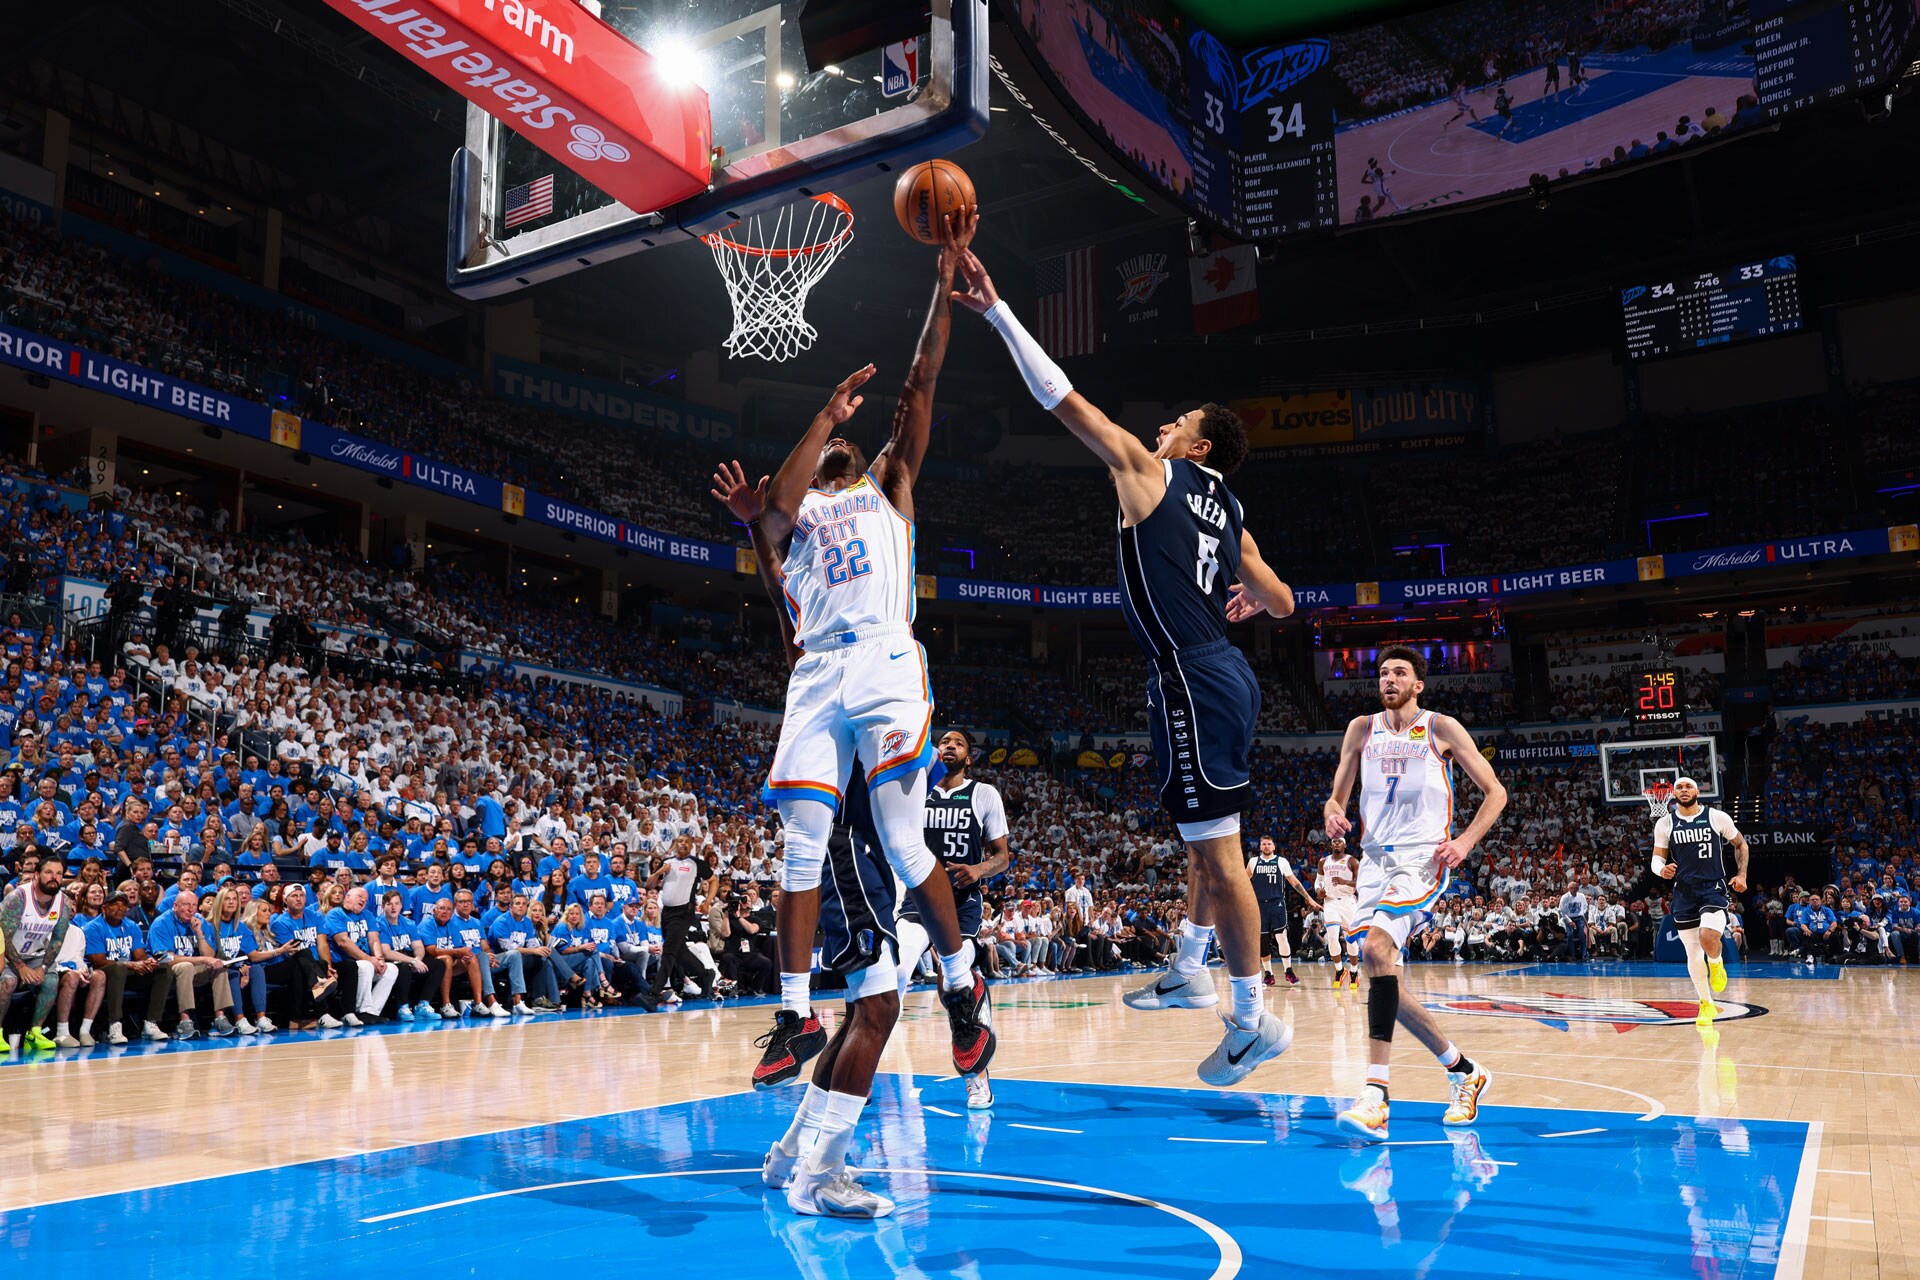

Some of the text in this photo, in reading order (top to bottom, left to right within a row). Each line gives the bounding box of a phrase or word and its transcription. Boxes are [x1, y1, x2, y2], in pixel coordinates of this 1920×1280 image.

[1755, 16, 1784, 33] PLAYER
[1755, 32, 1781, 47] GREEN
[1757, 40, 1798, 61] HARDAWAY
[1799, 37, 1812, 47] JR.
[1852, 33, 1858, 43] 4
[1758, 57, 1795, 76] GAFFORD
[1855, 49, 1860, 58] 0
[888, 75, 905, 91] NBA
[1760, 58, 1877, 90] JONES JR. 10 0
[1761, 88, 1792, 105] DONCIC
[1768, 107, 1779, 117] TO
[1795, 99, 1804, 109] TF
[1808, 95, 1814, 104] 3
[1828, 84, 1846, 97] 2ND
[1857, 75, 1876, 88] 7:46
[1204, 90, 1225, 135] 33
[1267, 102, 1306, 143] 34
[1244, 153, 1267, 163] PLAYER
[1311, 143, 1323, 152] PTS
[1325, 141, 1334, 149] FL
[1244, 158, 1311, 175] GILGEOUS-ALEXANDER
[1245, 179, 1261, 188] DORT
[1245, 188, 1279, 200] HOLMGREN
[1245, 202, 1273, 212] WIGGINS
[1317, 193, 1325, 201] 10
[918, 189, 930, 240] Wilson
[1246, 214, 1274, 225] WALLACE
[1251, 228, 1260, 237] TO
[1298, 221, 1311, 230] 2ND
[1115, 253, 1168, 281] THUNDER
[1740, 264, 1764, 280] 33
[1651, 282, 1675, 299] 34
[1693, 277, 1719, 289] 7:46
[0, 332, 231, 421] RIOR LIGHT BEER
[497, 369, 732, 442] THUNDER UP
[1358, 389, 1476, 434] LOUD CITY
[1249, 435, 1465, 462] BRING THE THUNDER EXIT NOW
[97, 447, 107, 485] 209
[330, 438, 478, 496] Michelob ULTRA
[793, 493, 881, 543] OKLAHOMA
[547, 503, 710, 562] SUPERIOR LIGHT BEER
[818, 516, 858, 547] CITY
[822, 537, 873, 589] 22
[1692, 538, 1857, 571] Michelob ULTRA
[1403, 567, 1606, 599] SUPERIOR LIGHT BEER
[959, 583, 1031, 602] SUPERIOR
[1043, 590, 1088, 605] LIGHT
[1294, 590, 1330, 604] TRA
[68, 594, 107, 620] 106
[1610, 661, 1658, 674] POST OAK
[1350, 680, 1366, 691] POST
[1448, 675, 1492, 687] POST OAK
[1643, 672, 1675, 687] 7:45
[663, 699, 681, 715] 107
[1639, 685, 1676, 710] 20
[1647, 711, 1681, 720] TISSOT
[1172, 709, 1200, 809] MAVERICKS
[1366, 740, 1430, 761] OKLAHOMA
[1499, 749, 1518, 760] THE
[1520, 746, 1567, 758] OFFICIAL
[1567, 744, 1600, 757] TA
[1381, 758, 1408, 774] CITY
[1386, 775, 1401, 805] 7
[923, 807, 972, 829] MAVS
[943, 832, 969, 858] 55
[1673, 827, 1712, 844] MAVS
[1773, 831, 1816, 845] BANK
[1698, 843, 1713, 859] 21
[1256, 865, 1278, 874] MAVS
[1267, 874, 1277, 884] 77
[18, 922, 54, 933] OKLAHOM
[24, 932, 42, 940] CITY
[21, 940, 32, 953] 8
